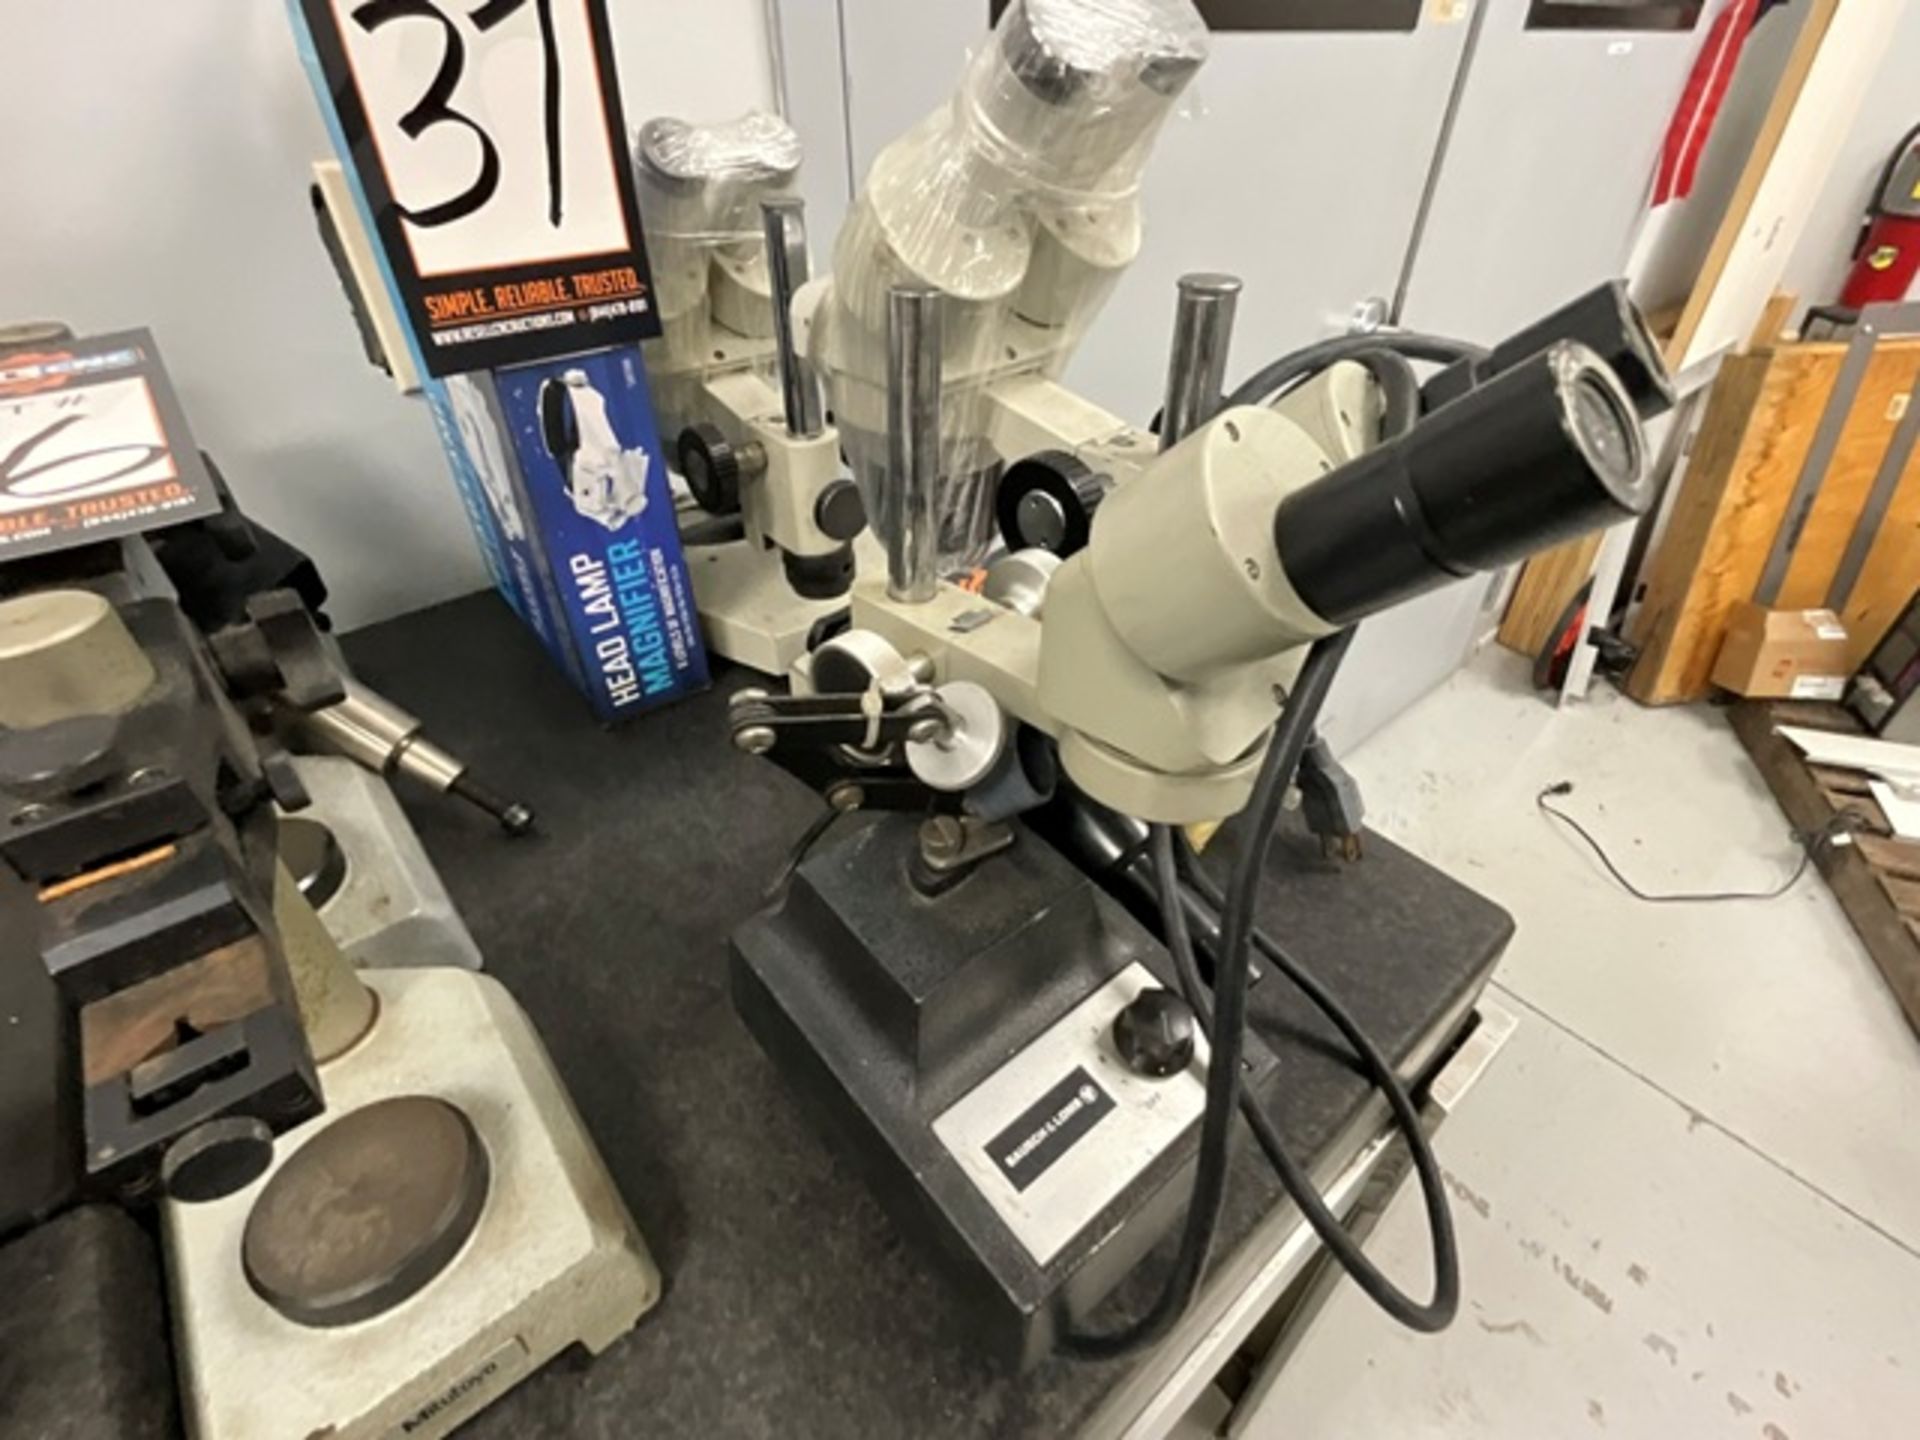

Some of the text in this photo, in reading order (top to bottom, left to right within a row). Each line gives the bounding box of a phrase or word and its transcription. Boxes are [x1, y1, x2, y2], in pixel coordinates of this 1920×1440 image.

[425, 287, 495, 321] SIMPLE.
[494, 277, 573, 311] RELIABLE.
[569, 552, 641, 707] HEAD LAMP
[607, 538, 674, 695] MAGNIFIER
[402, 1361, 498, 1433] Mitutoyo
